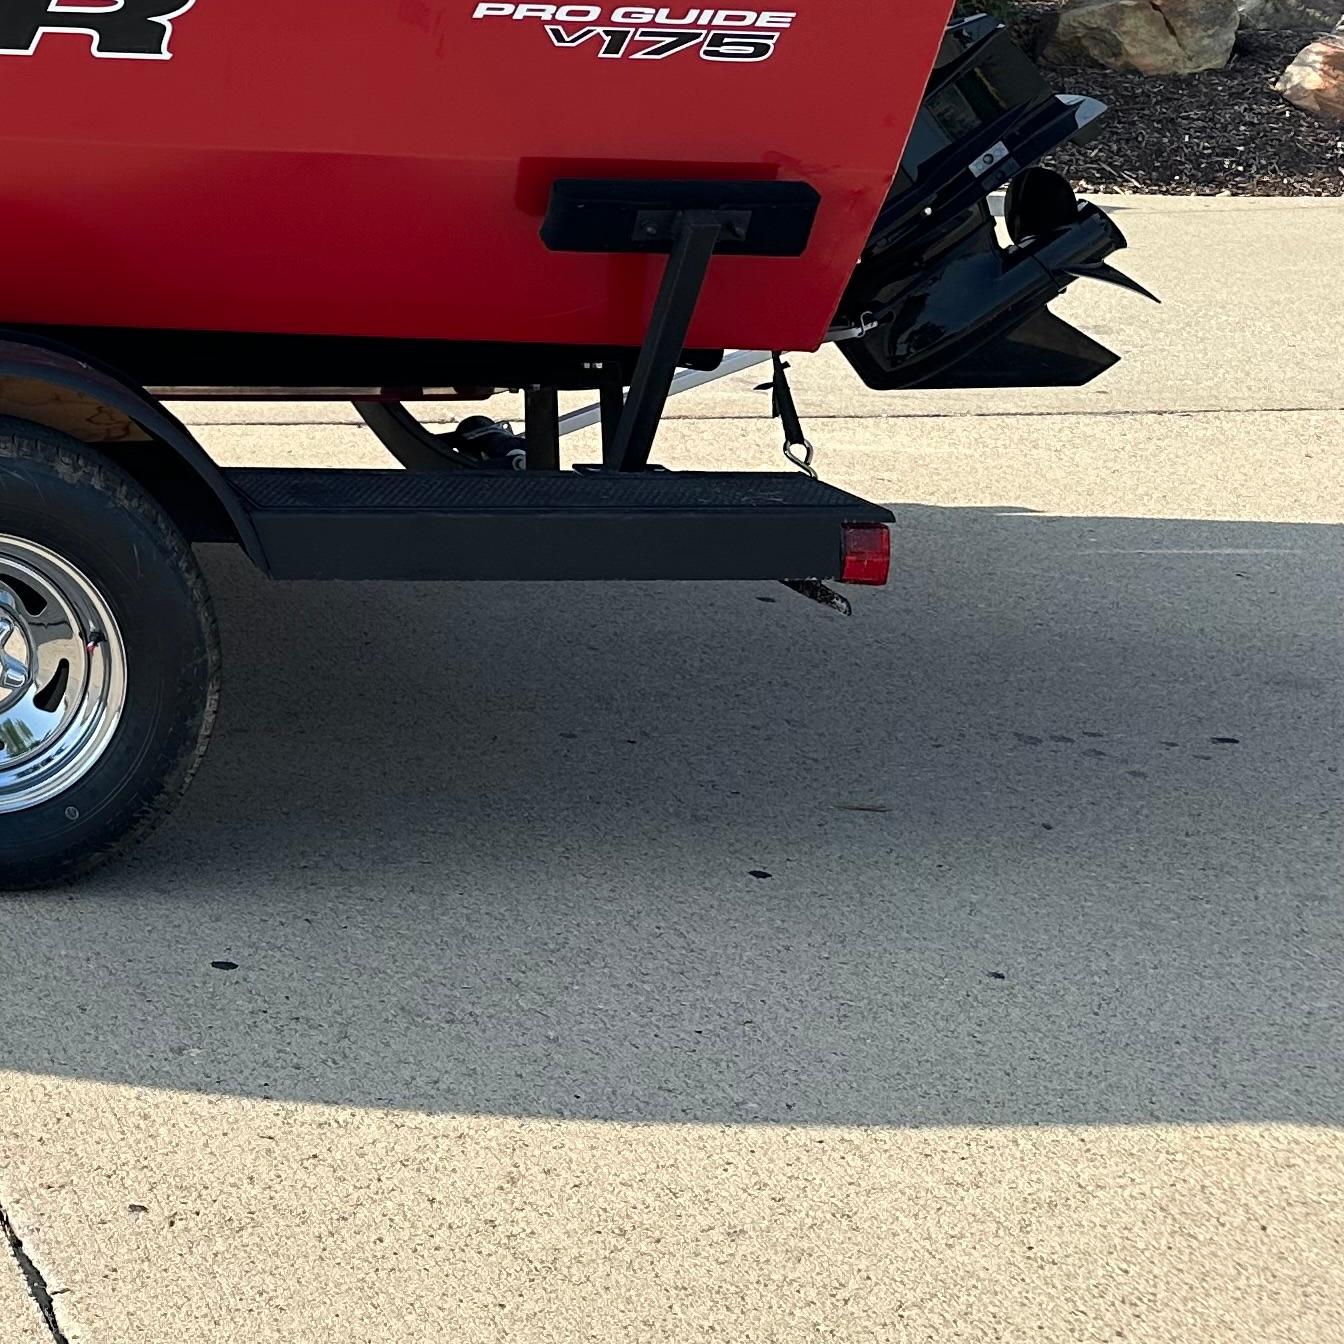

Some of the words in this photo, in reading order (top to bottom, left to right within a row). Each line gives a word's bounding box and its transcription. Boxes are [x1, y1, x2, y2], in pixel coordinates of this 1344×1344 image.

[471, 2, 602, 22] PRO
[610, 6, 797, 29] GUIDE
[543, 25, 780, 63] V175
